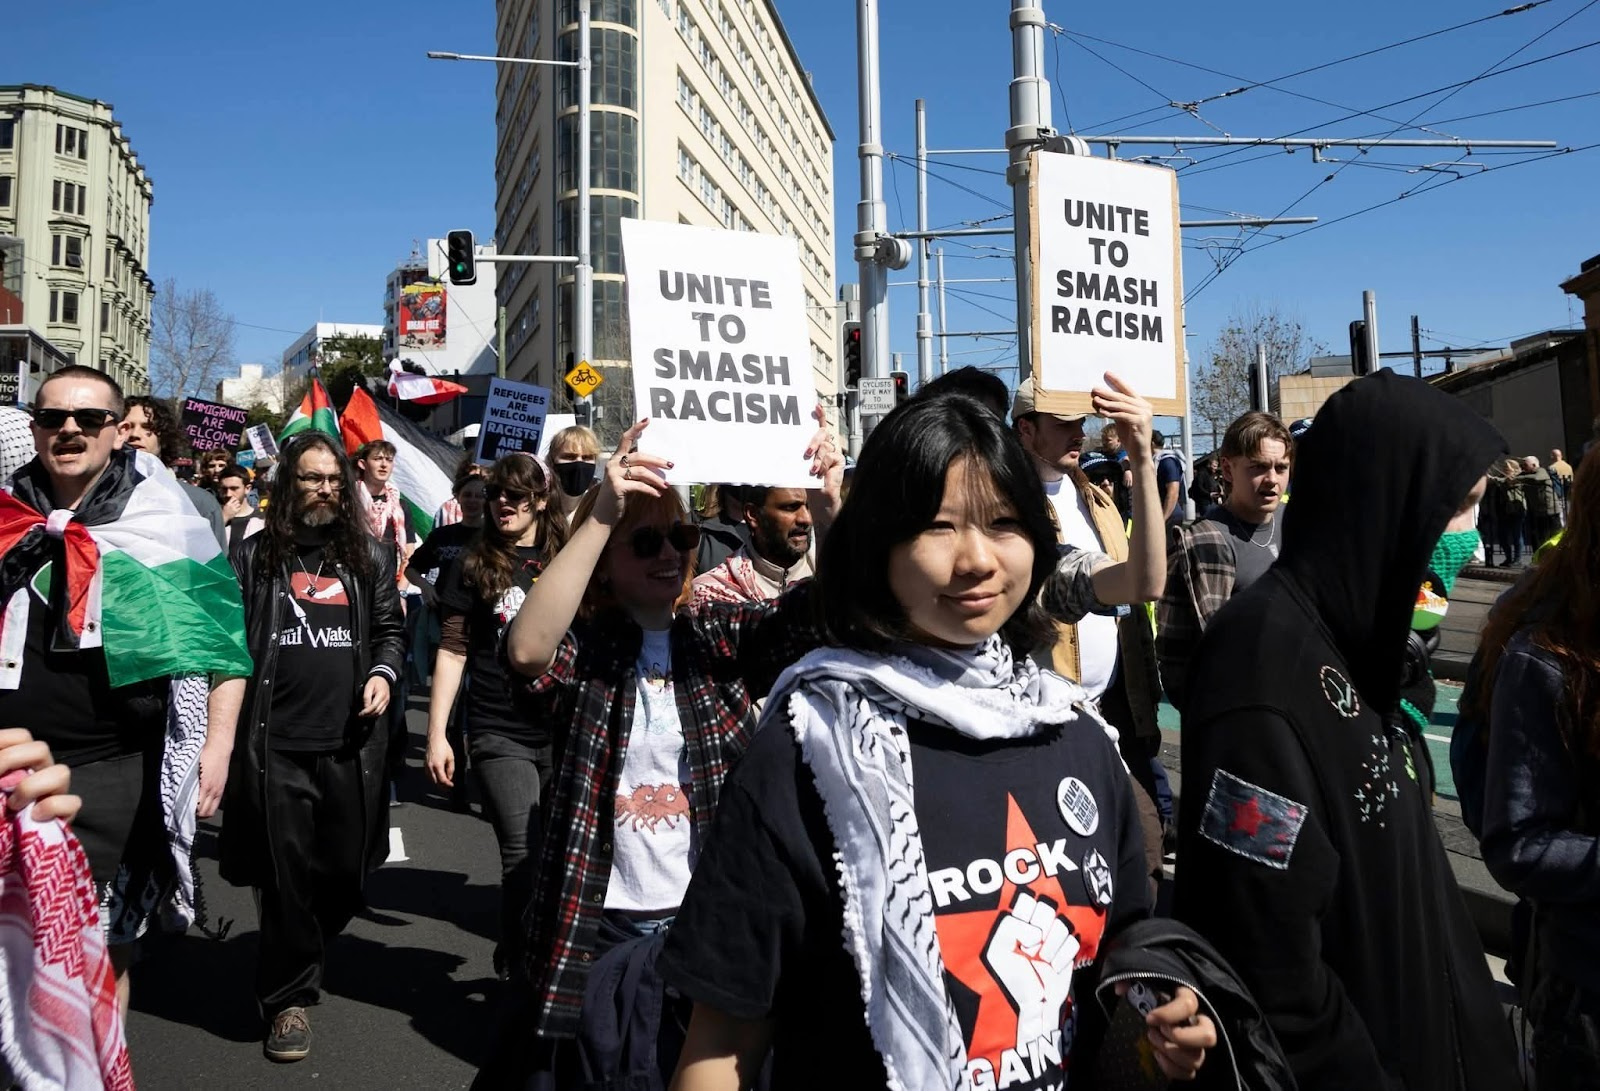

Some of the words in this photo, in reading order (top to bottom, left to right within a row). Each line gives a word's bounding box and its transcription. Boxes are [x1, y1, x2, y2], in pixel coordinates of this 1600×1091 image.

[1064, 198, 1149, 237] UNITE
[1088, 237, 1129, 268] TO
[659, 269, 772, 309] UNITE
[1056, 269, 1158, 307] SMASH
[691, 311, 746, 344] TO
[1051, 305, 1163, 343] RACISM
[653, 347, 791, 386] SMASH
[493, 387, 545, 405] REFUGEES
[507, 400, 528, 412] ARE
[649, 387, 801, 426] RACISM
[186, 400, 247, 424] IMMIGRANTS
[201, 416, 225, 430] ARE
[490, 407, 542, 425] WELCOME
[487, 422, 538, 440] RACISTS
[498, 436, 523, 450] ARE
[495, 448, 513, 458] NO
[279, 625, 303, 646] aul
[928, 838, 1079, 907] ROCK
